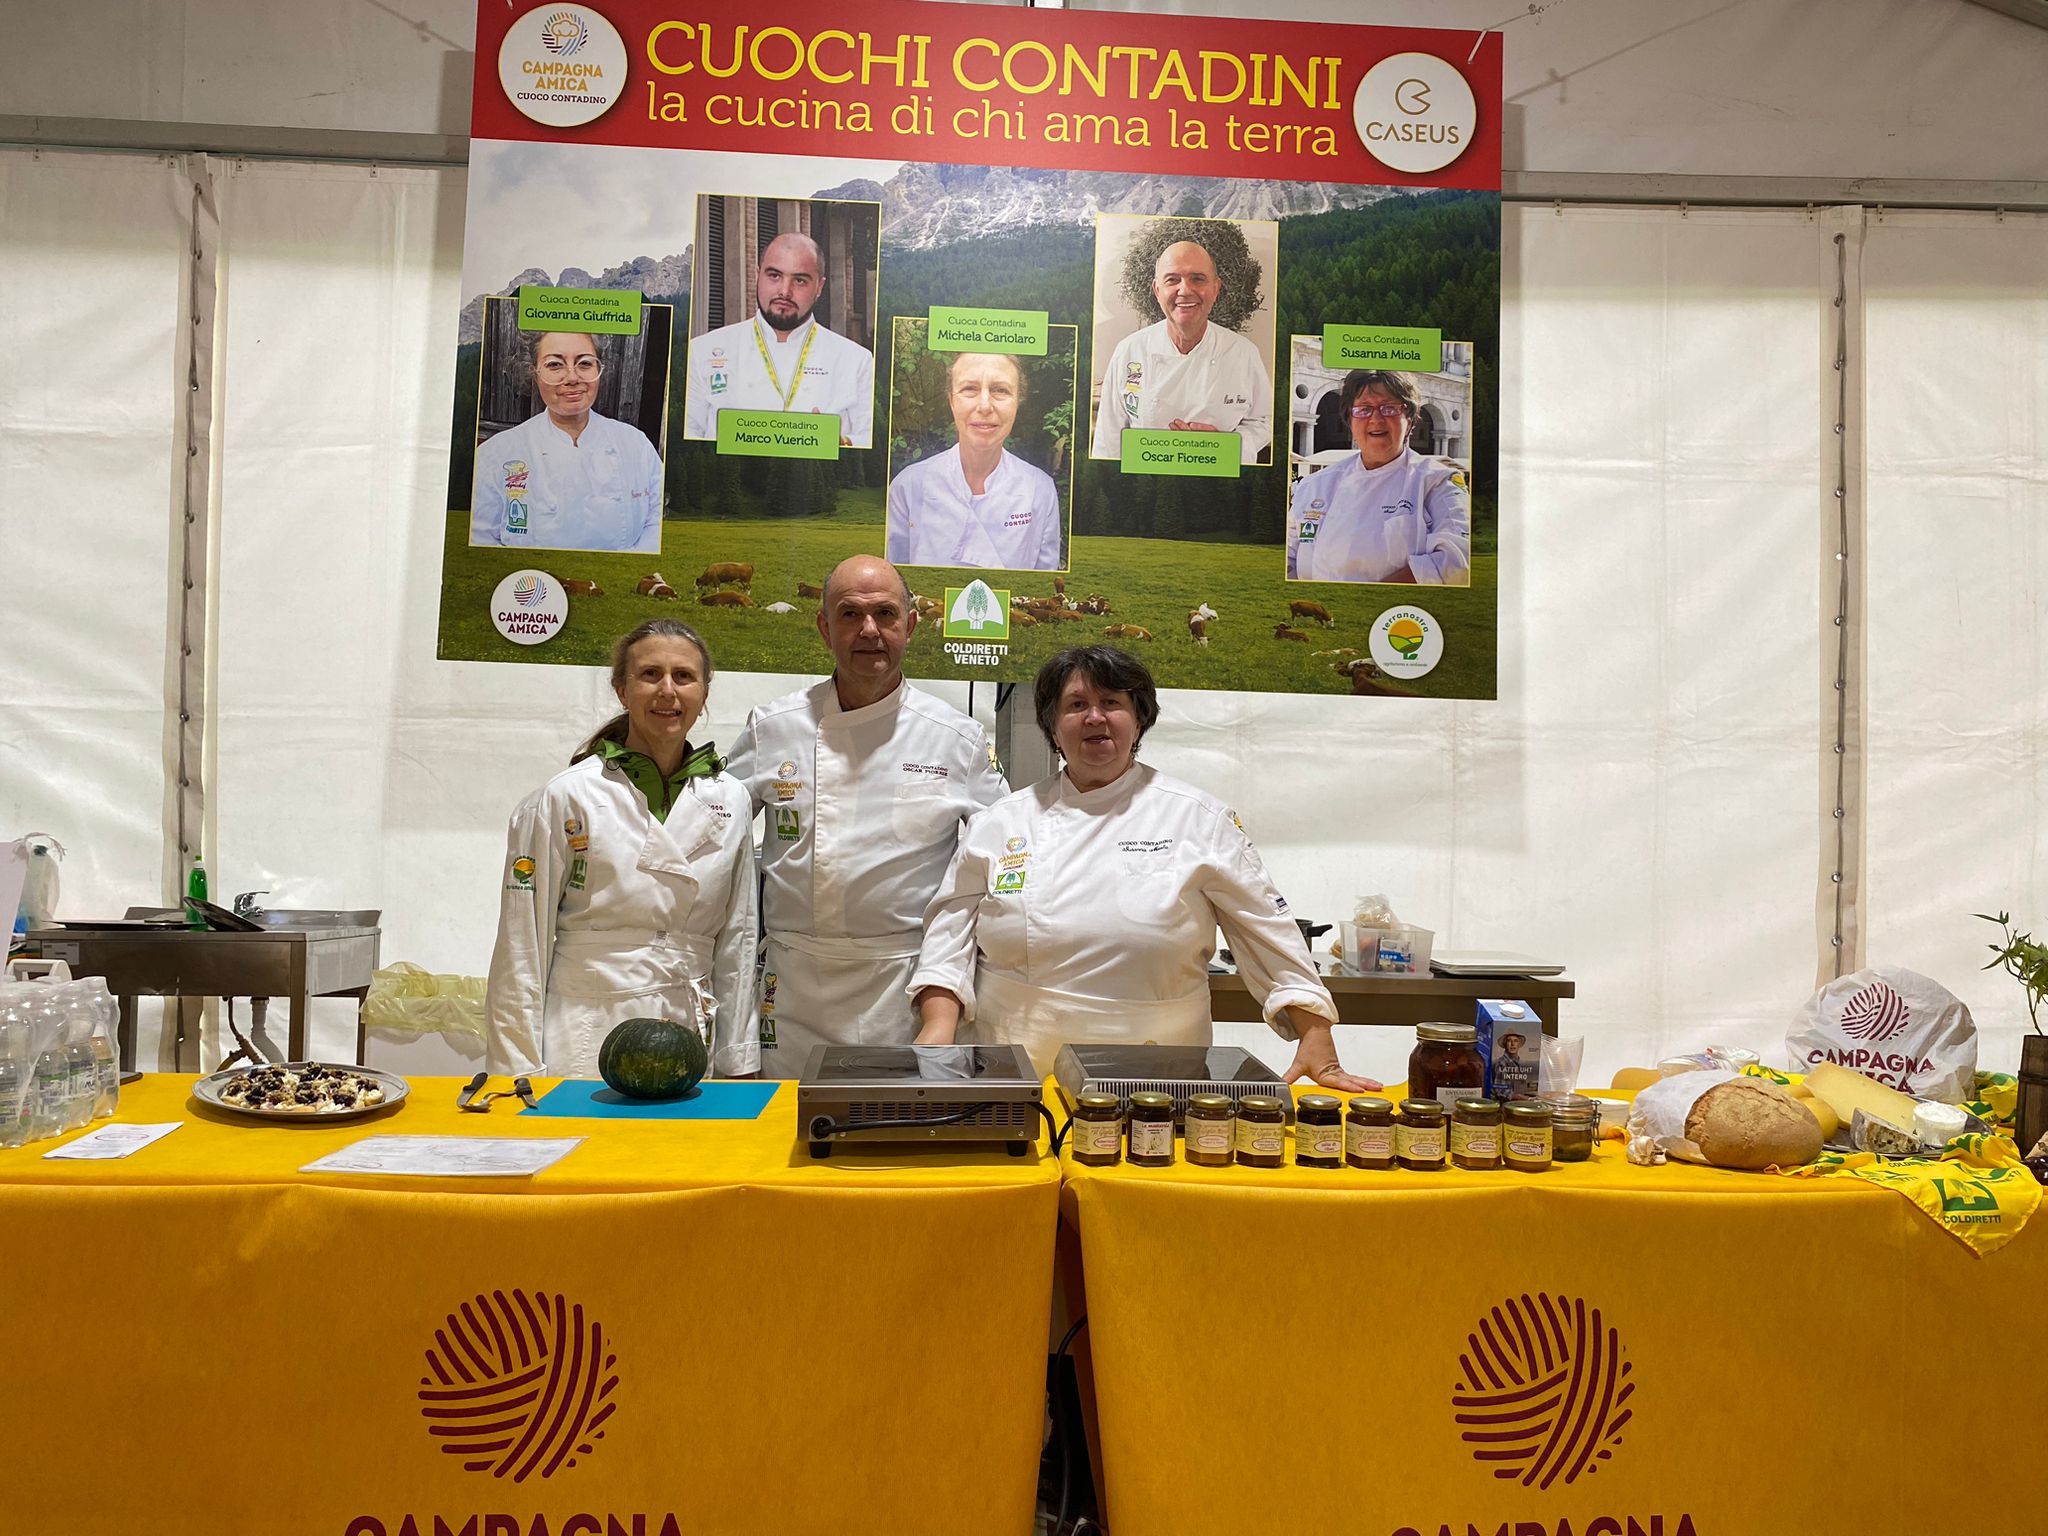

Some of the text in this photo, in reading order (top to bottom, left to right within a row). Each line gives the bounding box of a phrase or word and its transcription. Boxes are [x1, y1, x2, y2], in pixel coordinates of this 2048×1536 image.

[522, 61, 603, 77] CAMPAGNA
[646, 20, 1342, 110] CUOCHI CONTADINI
[535, 76, 588, 92] AMICA
[517, 93, 607, 104] CUOCO CONTADINO
[647, 81, 1338, 156] la cucina di chi ama la terra
[1366, 121, 1460, 144] CASEUS
[539, 294, 620, 306] Cuoca Contadina
[524, 308, 632, 323] Giovanna Giuffrida
[948, 316, 1027, 328] Cuoca Contadina
[937, 329, 1036, 344] Michela Cariolaro
[1342, 334, 1420, 345] Cuoca Contadina
[1341, 348, 1421, 361] Susanna Miola
[736, 418, 819, 431] Cuoco Contadino
[735, 432, 818, 446] Marco Vuerich
[1140, 437, 1220, 448] Cuoco Contadino
[1141, 451, 1217, 464] Oscar Fiorese
[498, 612, 559, 624] CAMPAGNA
[1382, 612, 1429, 632] terranostra
[507, 623, 547, 635] AMICA
[944, 643, 1008, 655] COLDIRETTI
[954, 654, 999, 665] VENETO
[1807, 1048, 1936, 1074] CAMPAGNA
[1943, 1215, 2001, 1224] COLDIRETTI
